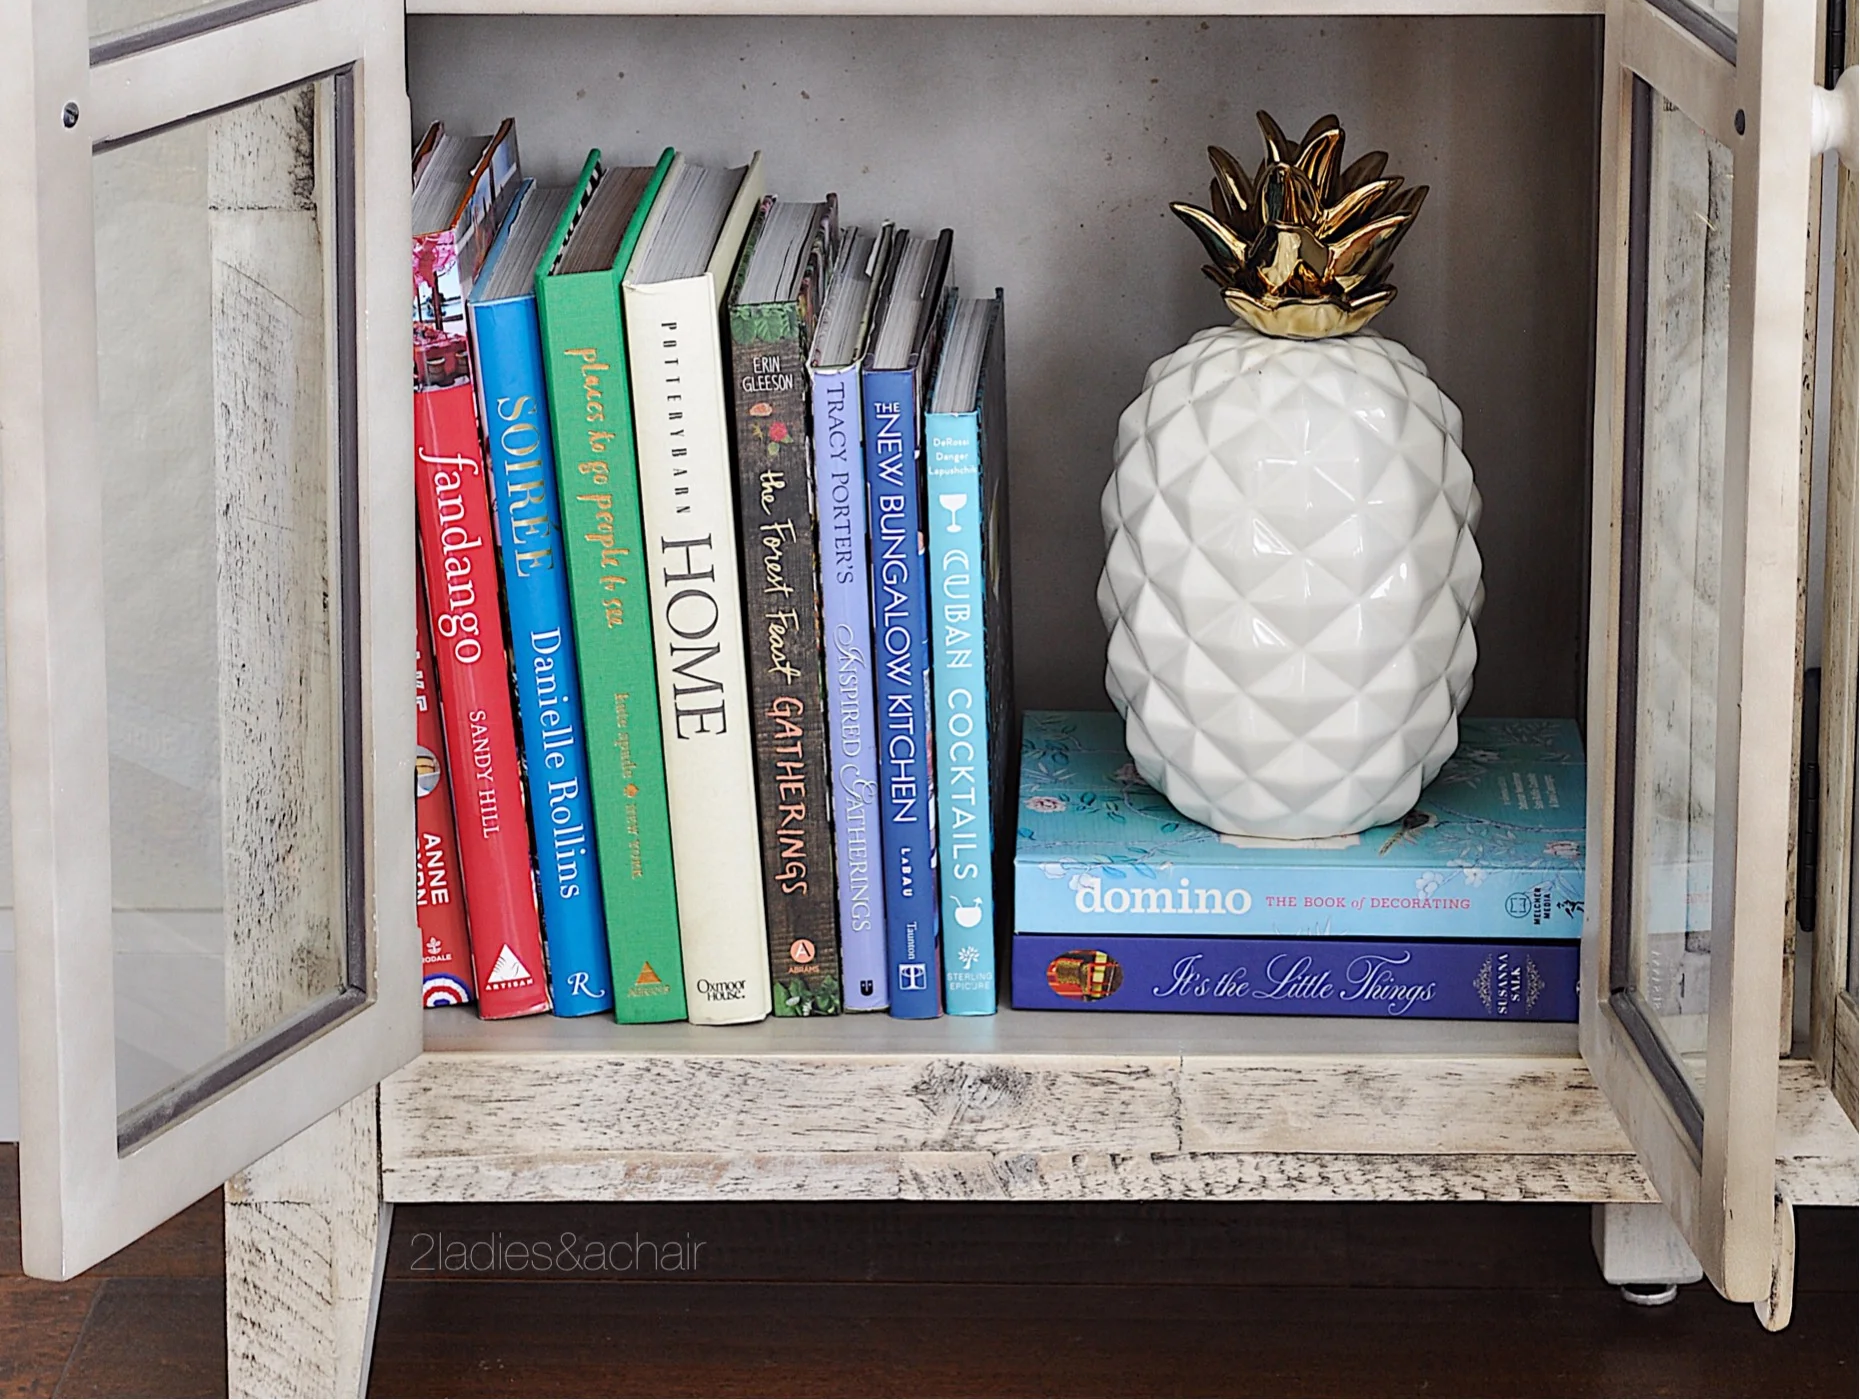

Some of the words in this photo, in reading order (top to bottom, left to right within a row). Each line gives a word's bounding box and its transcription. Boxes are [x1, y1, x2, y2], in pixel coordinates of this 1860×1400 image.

[564, 348, 609, 422] places
[742, 375, 794, 391] GLEESON
[753, 357, 780, 372] ERIN
[827, 382, 847, 462] TRACY
[875, 403, 900, 412] THE
[578, 460, 608, 485] go
[588, 430, 615, 453] to
[876, 413, 903, 486] NEW
[933, 437, 970, 447] DeRossi
[936, 452, 968, 463] Danger
[760, 470, 786, 515] the
[419, 447, 482, 664] fandango
[577, 493, 629, 567] people
[760, 519, 796, 598] Forest
[832, 473, 853, 584] PORTER'S
[603, 597, 623, 629] see
[879, 496, 912, 686] BUNGALOW
[943, 550, 972, 668] CUBAN
[661, 533, 727, 740] HOME
[765, 609, 800, 685] Feast
[531, 626, 574, 769] Danielle
[833, 623, 866, 757] INSPIRED
[469, 710, 494, 783] SANDY
[888, 695, 917, 823] KITCHEN
[479, 789, 500, 839] HILL
[767, 696, 807, 894] GATHERINGS
[948, 688, 977, 880] COCKTAILS
[423, 832, 450, 905] ANNE
[548, 777, 588, 899] Rollins
[839, 763, 878, 932] GATHERINGS
[901, 848, 912, 897] LABAU
[1075, 878, 1251, 914] domino
[1266, 897, 1297, 907] THE
[1304, 897, 1346, 908] BOOK
[1351, 896, 1365, 908] of
[1370, 897, 1471, 909] DECORATING
[788, 965, 819, 974] ABRAMS
[907, 921, 917, 960] Taunton
[485, 978, 534, 991] ARTISAN
[697, 979, 746, 994] Oxmoor
[947, 971, 992, 981] STERLING
[950, 981, 990, 991] EPICURE
[1153, 955, 1211, 997] It's
[1214, 967, 1249, 997] the
[1252, 953, 1334, 1000] Little
[1340, 951, 1436, 1015] Things
[1498, 953, 1507, 1014] SUSANNA
[1511, 966, 1520, 1002] SALK
